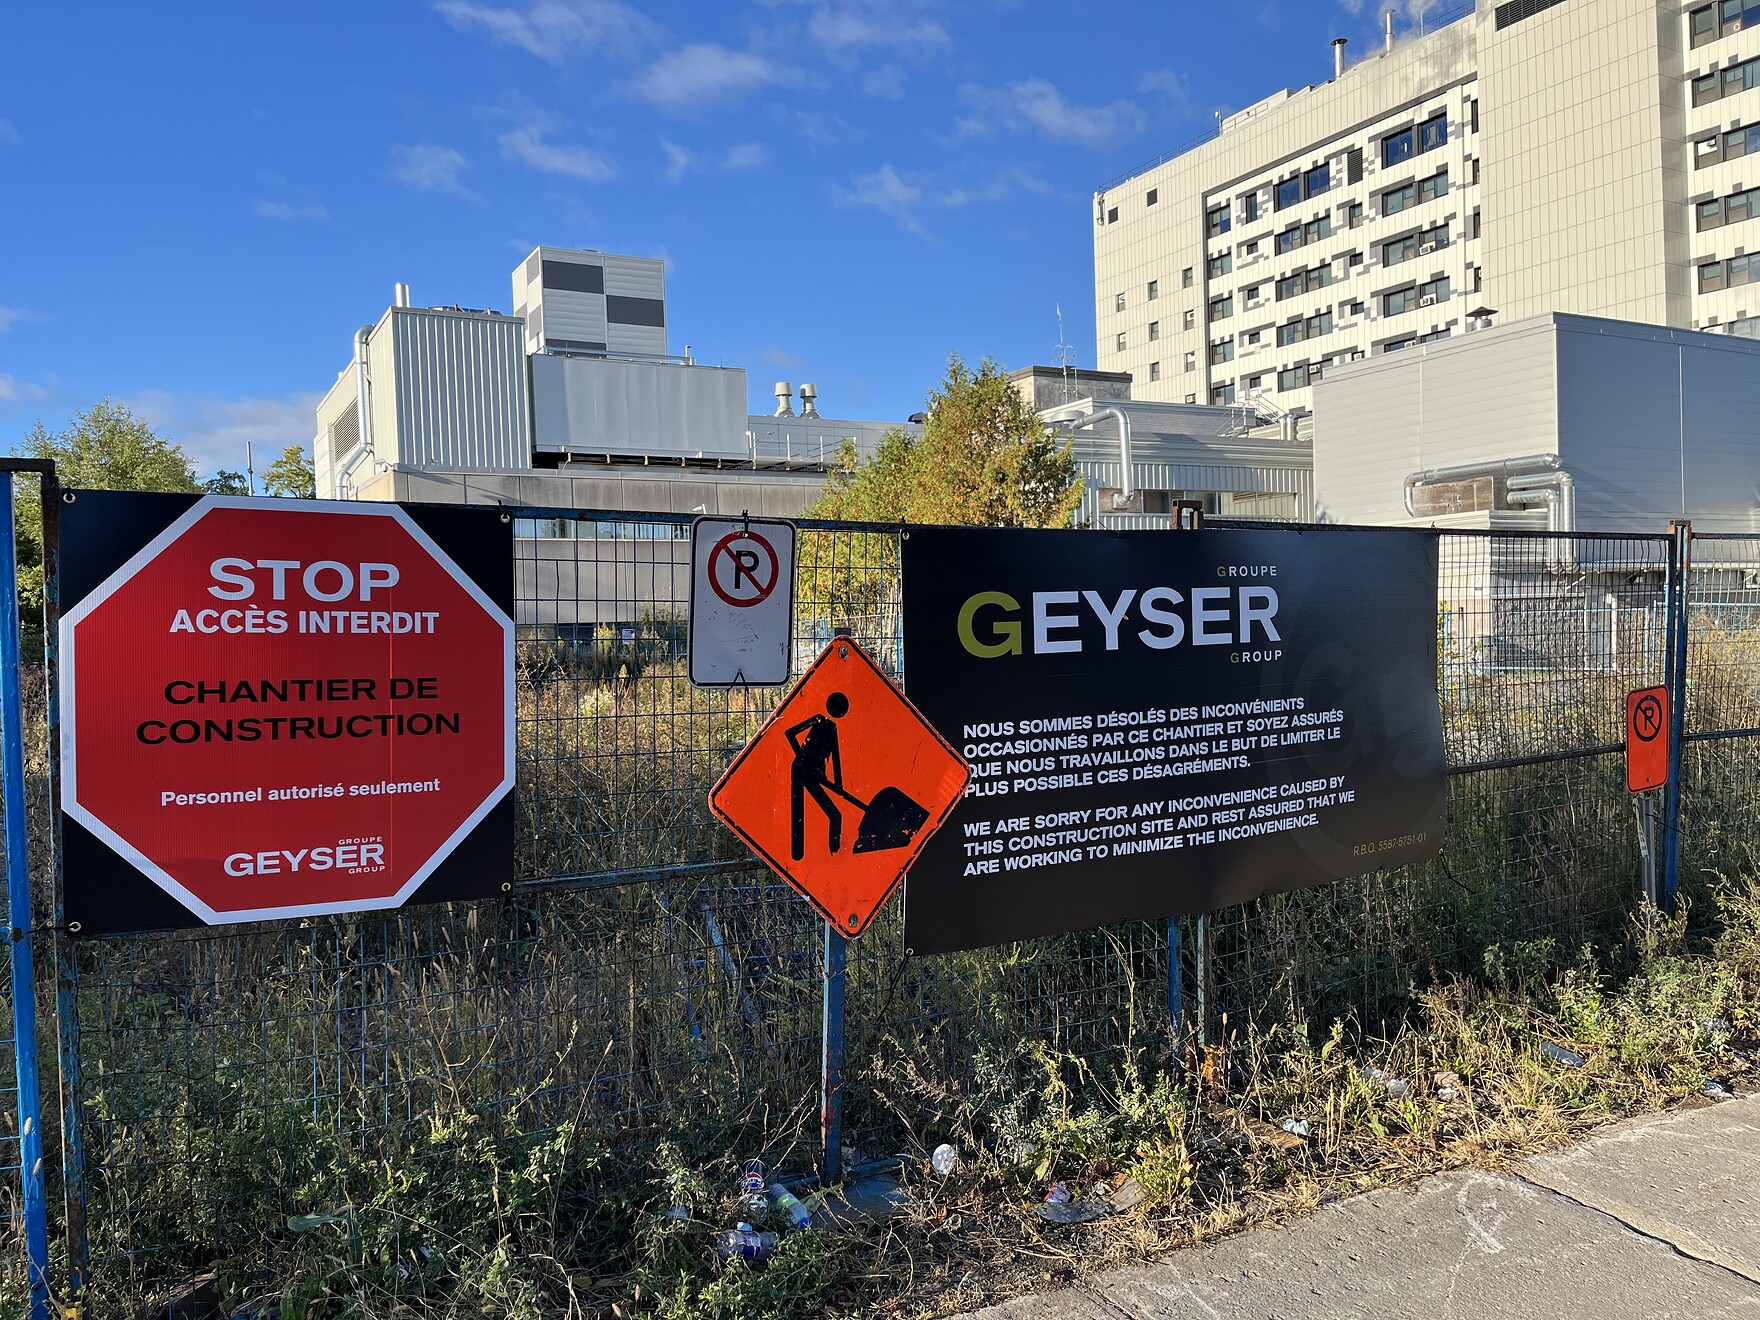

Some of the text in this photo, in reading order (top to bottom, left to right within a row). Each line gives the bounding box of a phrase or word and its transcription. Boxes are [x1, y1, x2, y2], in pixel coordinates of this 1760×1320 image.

[207, 558, 400, 602] STOP
[1217, 565, 1277, 578] GROUPE
[169, 604, 440, 634] ACCÈS INTERDIT
[957, 585, 1281, 658] GEYSER
[1230, 650, 1283, 664] GROUP
[164, 677, 439, 705] CHANTIER DE
[135, 712, 461, 745] CONSTRUCTION
[963, 697, 1305, 738] NOUS SOMMES DÉSOLÉS DES INCONVÉNIENTS
[963, 708, 1344, 758] OCCASIONNÉS PAR CE CHANTIER ET SOYEZ ASSURÉS
[969, 727, 1341, 779] QUE NOUS TRAVAILLONS DANS LE BUT DE LIMITER LE
[161, 777, 440, 806] Personnel autorisé seulement
[964, 755, 1251, 798] PLUS POSSIBLE CES DÉSAGRÉMENTS.
[963, 775, 1345, 837] WE ARE SORRY FOR ANY INCONVENIENCE CAUSED BY
[338, 836, 383, 845] GROUPE
[963, 790, 1355, 857] THIS CONSTRUCTION SITE AND REST ASSURED THAT WE
[963, 813, 1319, 877] ARE WORKING TO MINIMIZE THE INCONVENIENCE.
[1378, 832, 1427, 851] 5587-5751-01
[223, 843, 385, 877] GEYSER
[348, 865, 386, 875] GROUP
